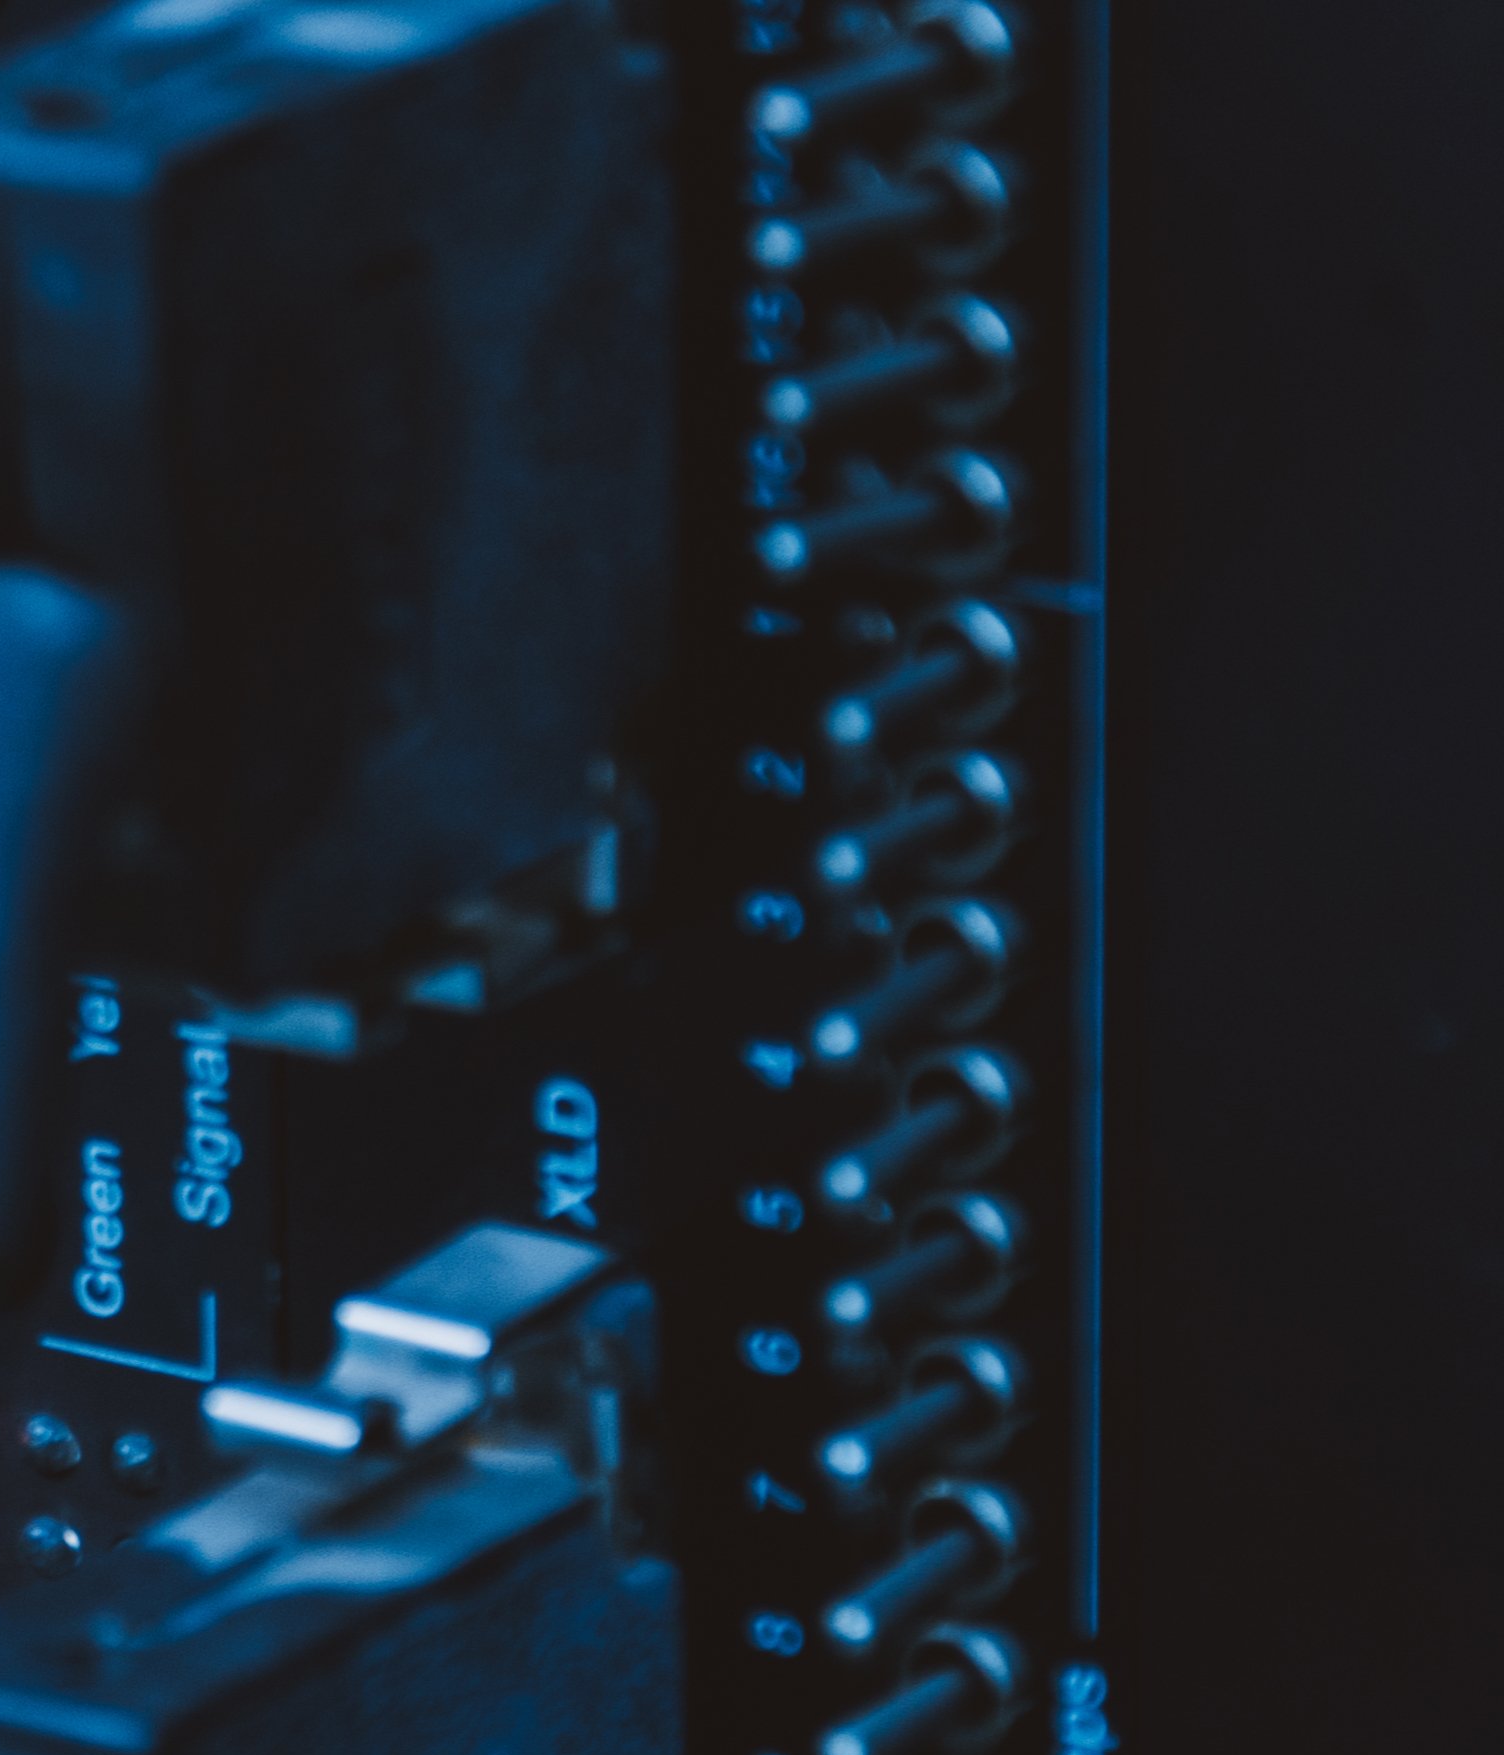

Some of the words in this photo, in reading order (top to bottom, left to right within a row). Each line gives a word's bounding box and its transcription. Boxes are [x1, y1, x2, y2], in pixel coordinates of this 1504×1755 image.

[744, 748, 807, 797] 2
[742, 890, 806, 939] 3
[745, 1039, 805, 1088] 4
[171, 1020, 245, 1230] Signal
[529, 1074, 602, 1232] XLD
[71, 1136, 127, 1320] Green
[742, 1186, 805, 1232] 5
[742, 1327, 803, 1377] 6
[748, 1471, 804, 1512] 7
[748, 1610, 805, 1658] 8
